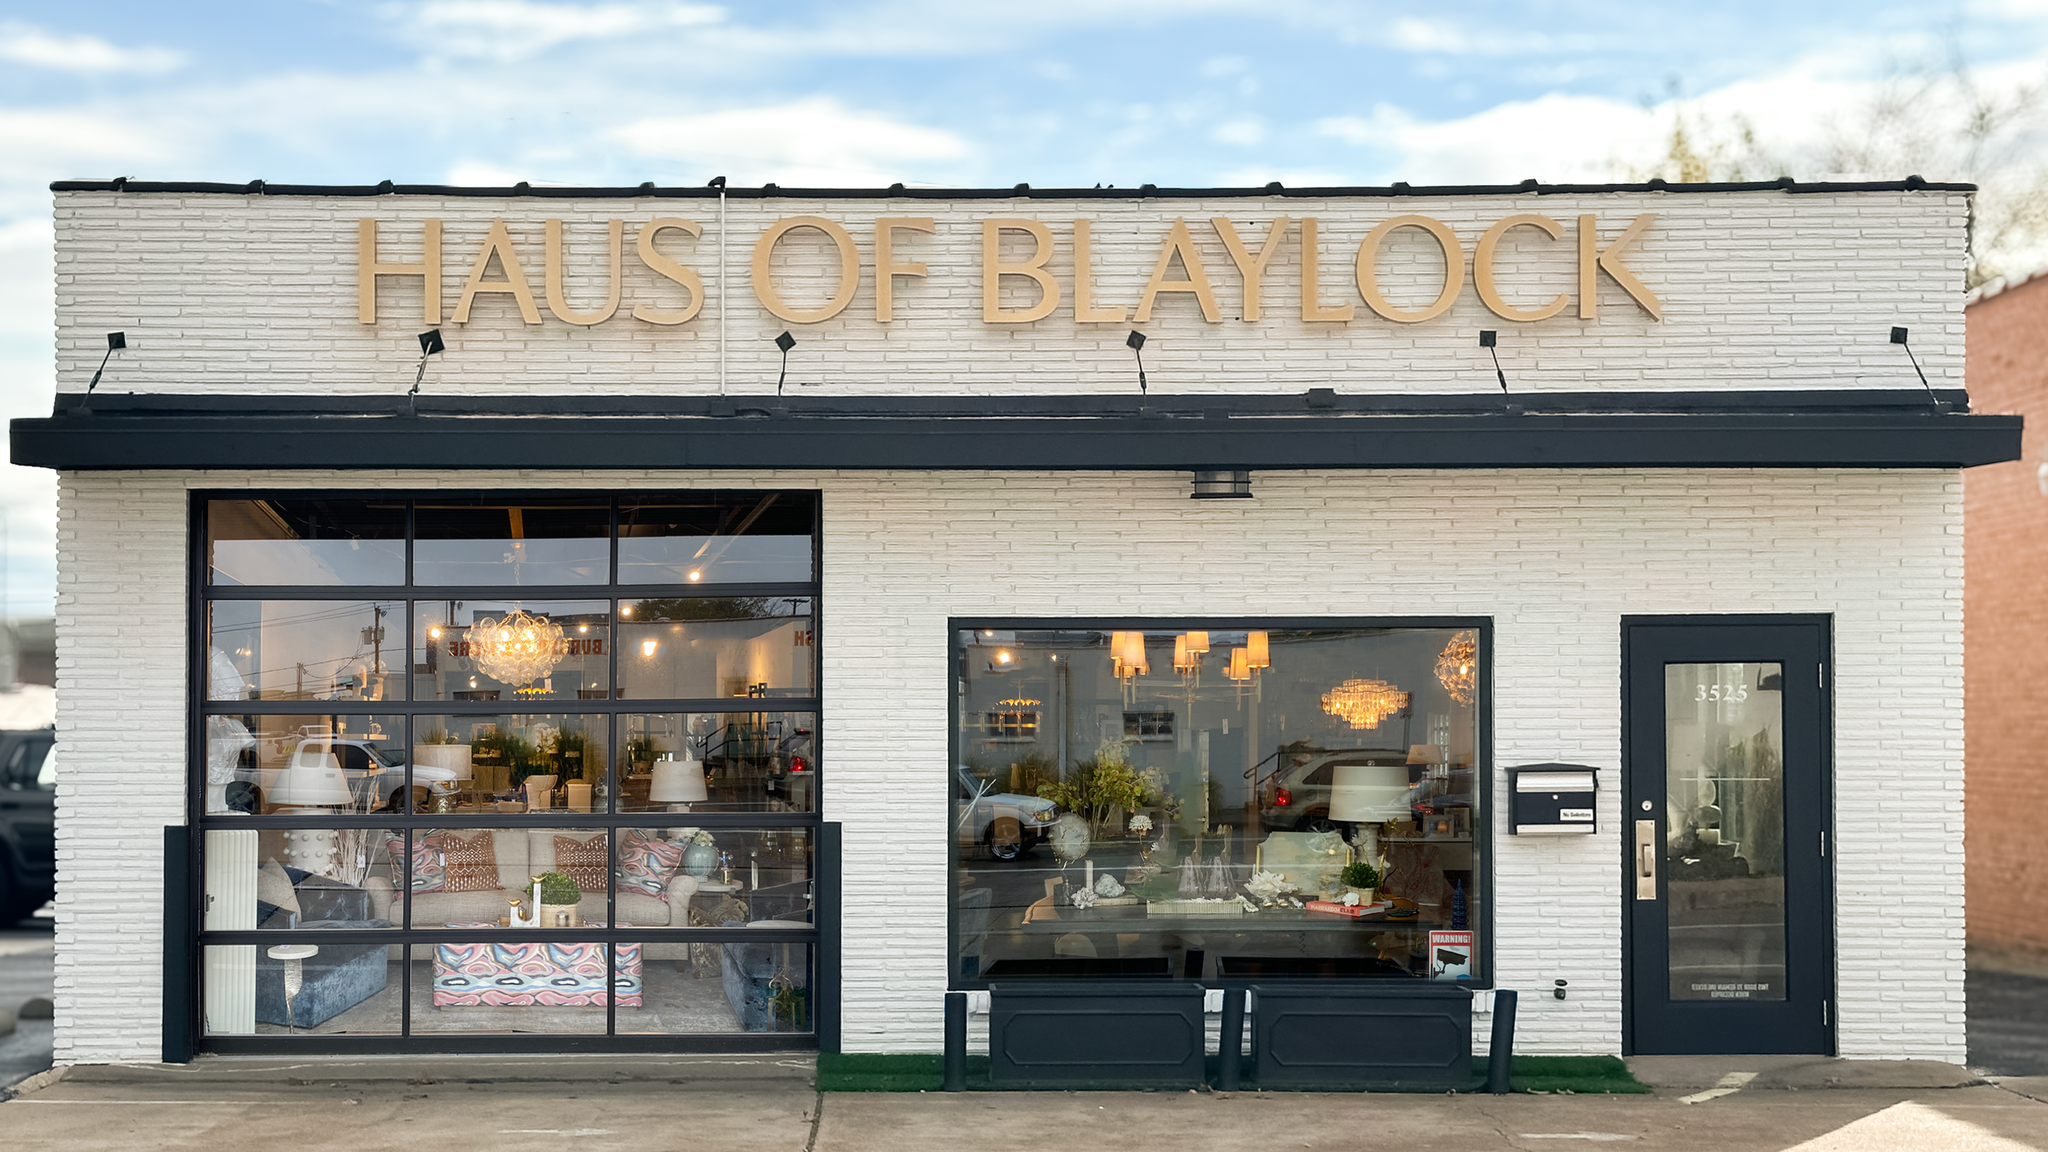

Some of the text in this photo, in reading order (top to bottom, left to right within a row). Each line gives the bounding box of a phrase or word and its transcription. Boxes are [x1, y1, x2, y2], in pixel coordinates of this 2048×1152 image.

[358, 213, 1662, 326] HAUS OF BLAYLOCK
[1695, 684, 1748, 702] 3525
[1432, 934, 1471, 943] WARNING!
